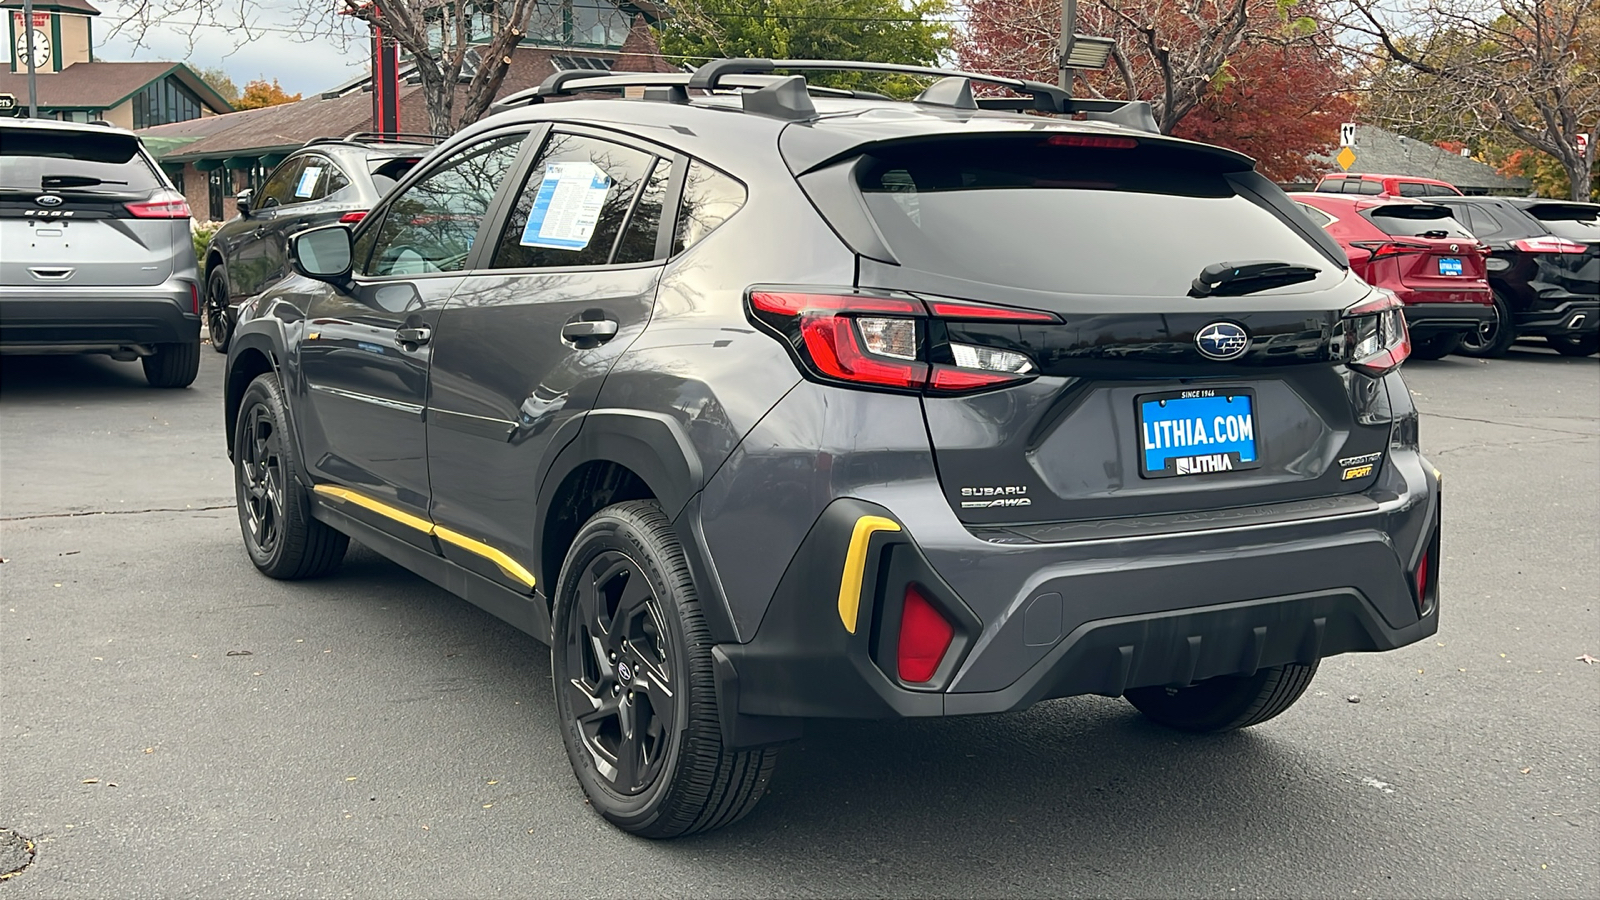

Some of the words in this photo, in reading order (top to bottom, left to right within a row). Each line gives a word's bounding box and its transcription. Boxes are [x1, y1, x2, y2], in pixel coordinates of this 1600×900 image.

[1143, 414, 1254, 450] LITHIA.COM
[1189, 453, 1233, 474] LITHIA
[1345, 466, 1373, 480] SPORT
[961, 486, 1027, 496] SUBARU
[988, 498, 1032, 508] AWD
